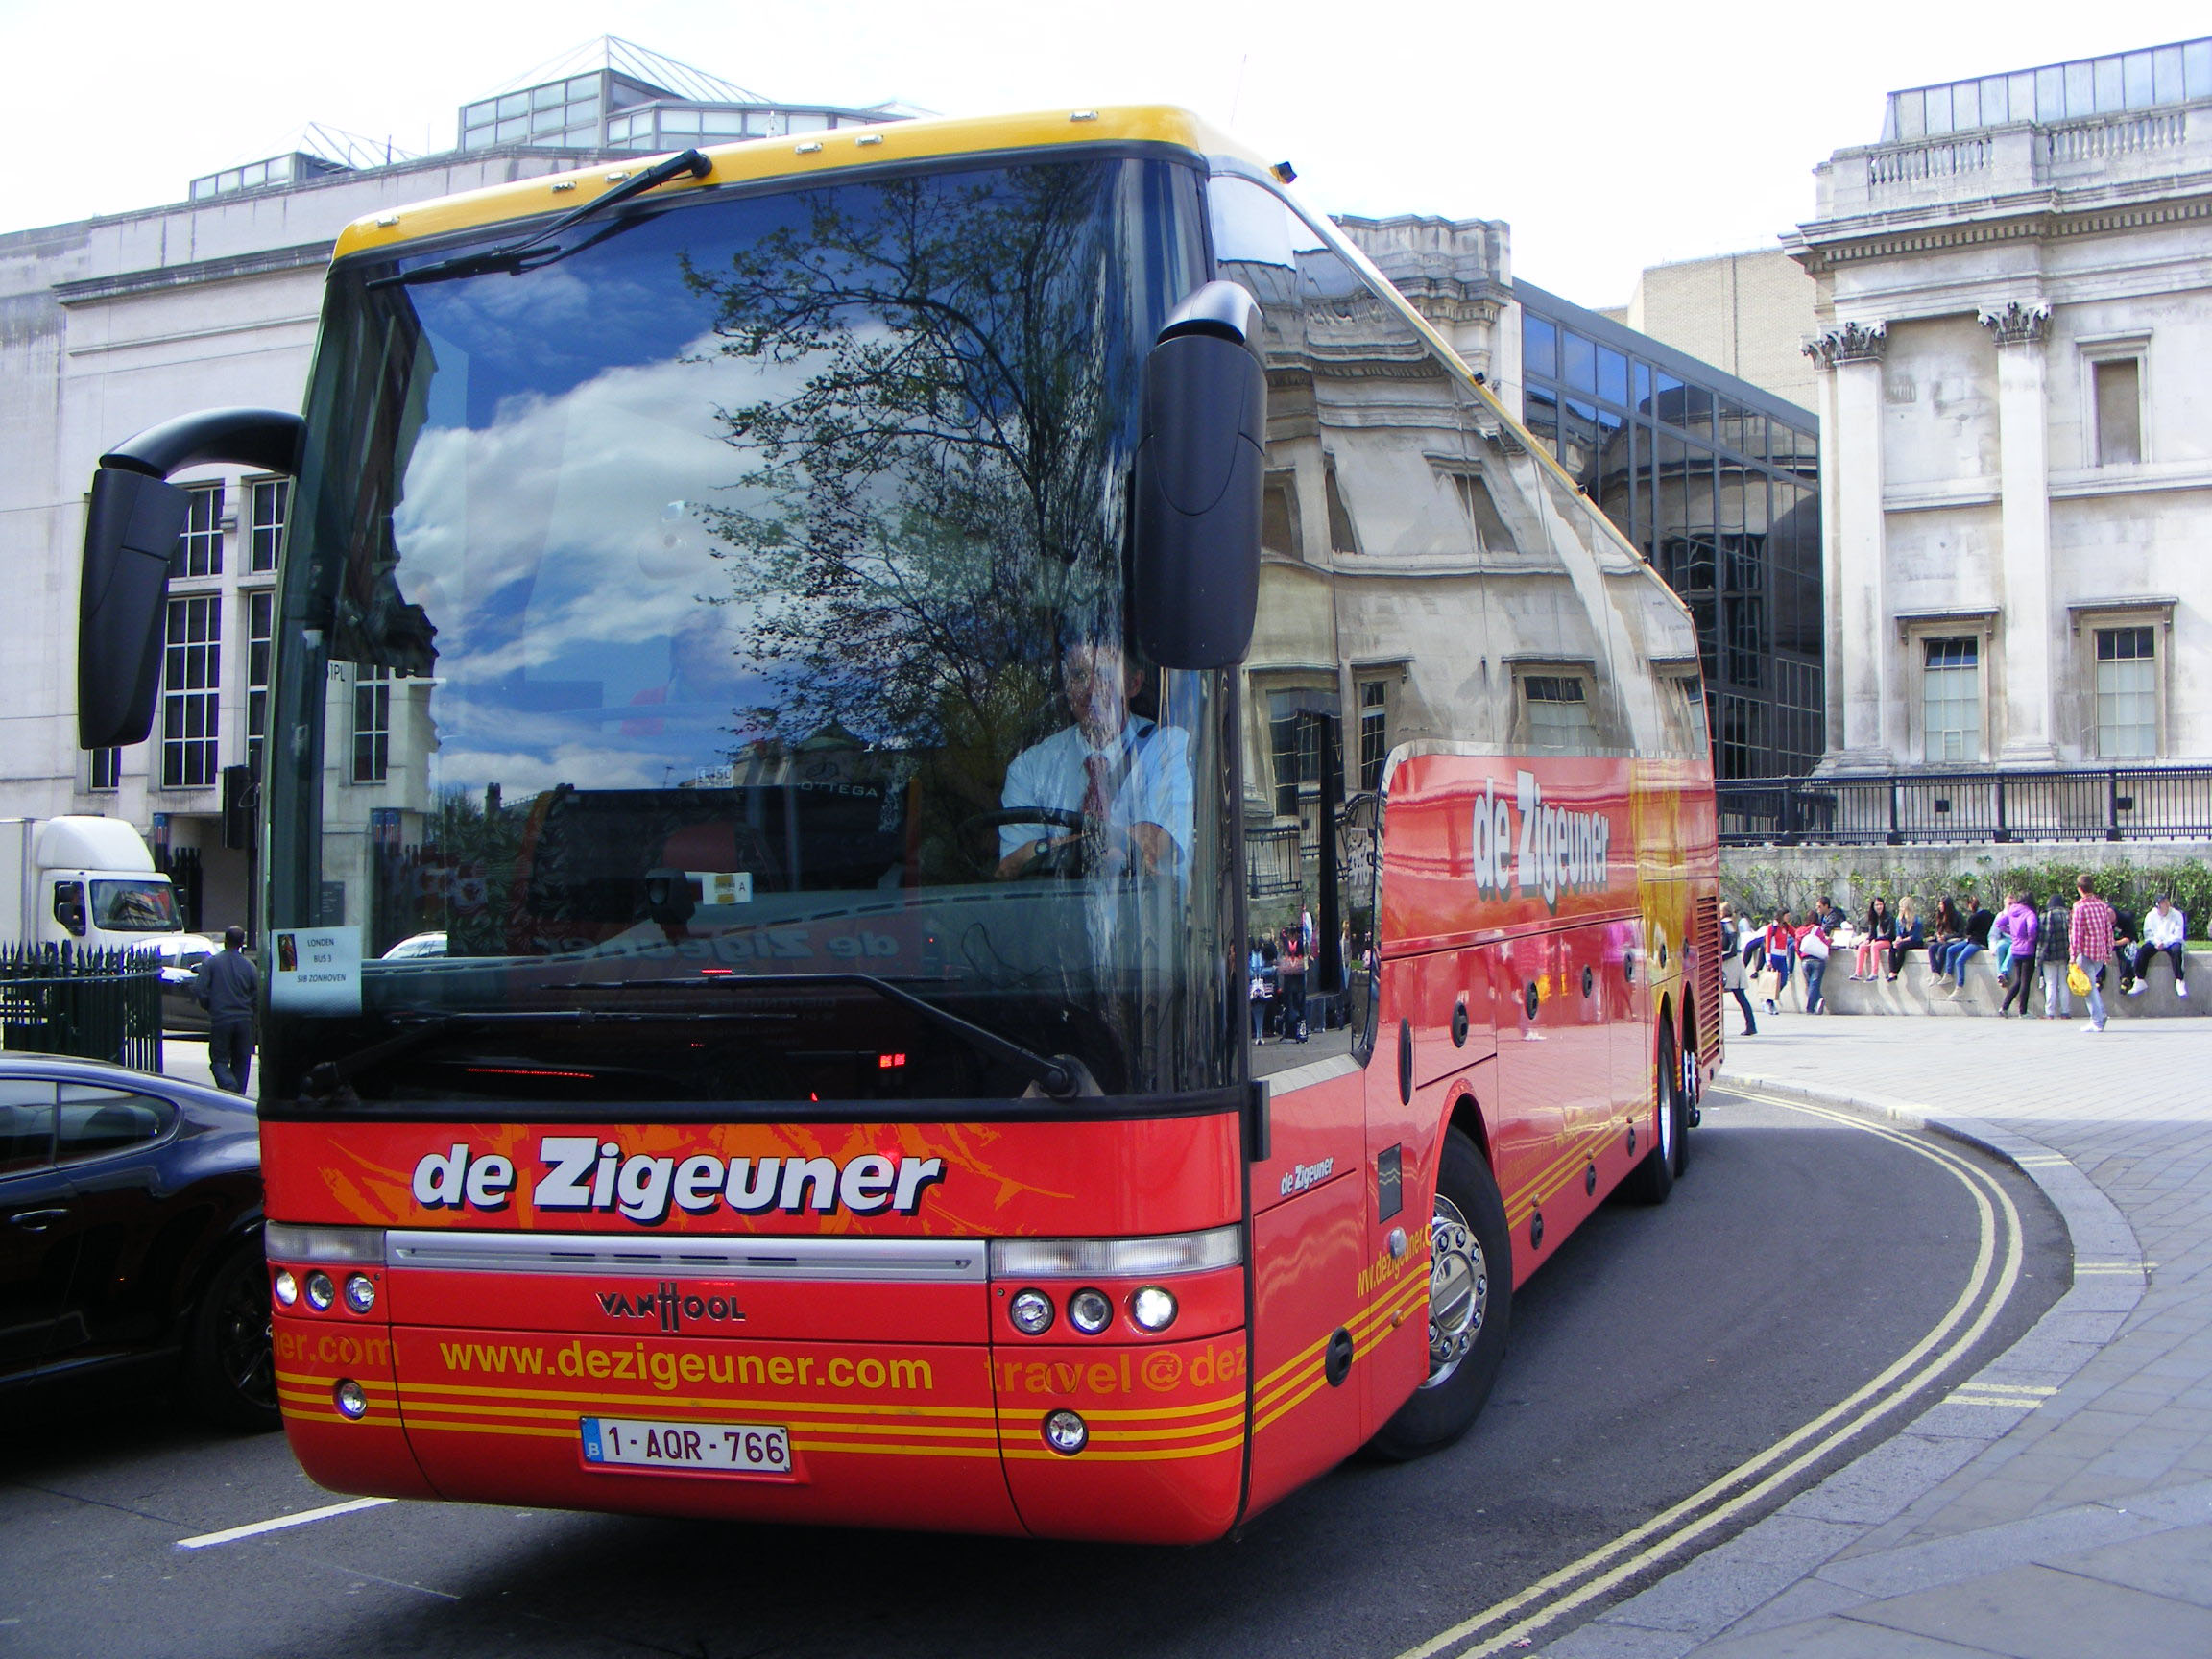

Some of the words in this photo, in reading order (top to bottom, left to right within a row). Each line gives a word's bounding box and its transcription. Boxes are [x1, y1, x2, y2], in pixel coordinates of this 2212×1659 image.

[1473, 777, 1511, 890] de
[1517, 770, 1609, 905] Zigeuner
[307, 938, 334, 947] LONDEN
[327, 954, 332, 963] 3
[308, 974, 346, 983] ZONHOVEN
[412, 1143, 515, 1208] de
[534, 1137, 943, 1223] Zigeuner
[1281, 1171, 1293, 1196] de
[1294, 1157, 1334, 1191] Zigeuner
[439, 1340, 933, 1391] www.dezigeuner.com
[588, 1442, 600, 1456] B
[608, 1426, 785, 1464] 1-AQR-766
